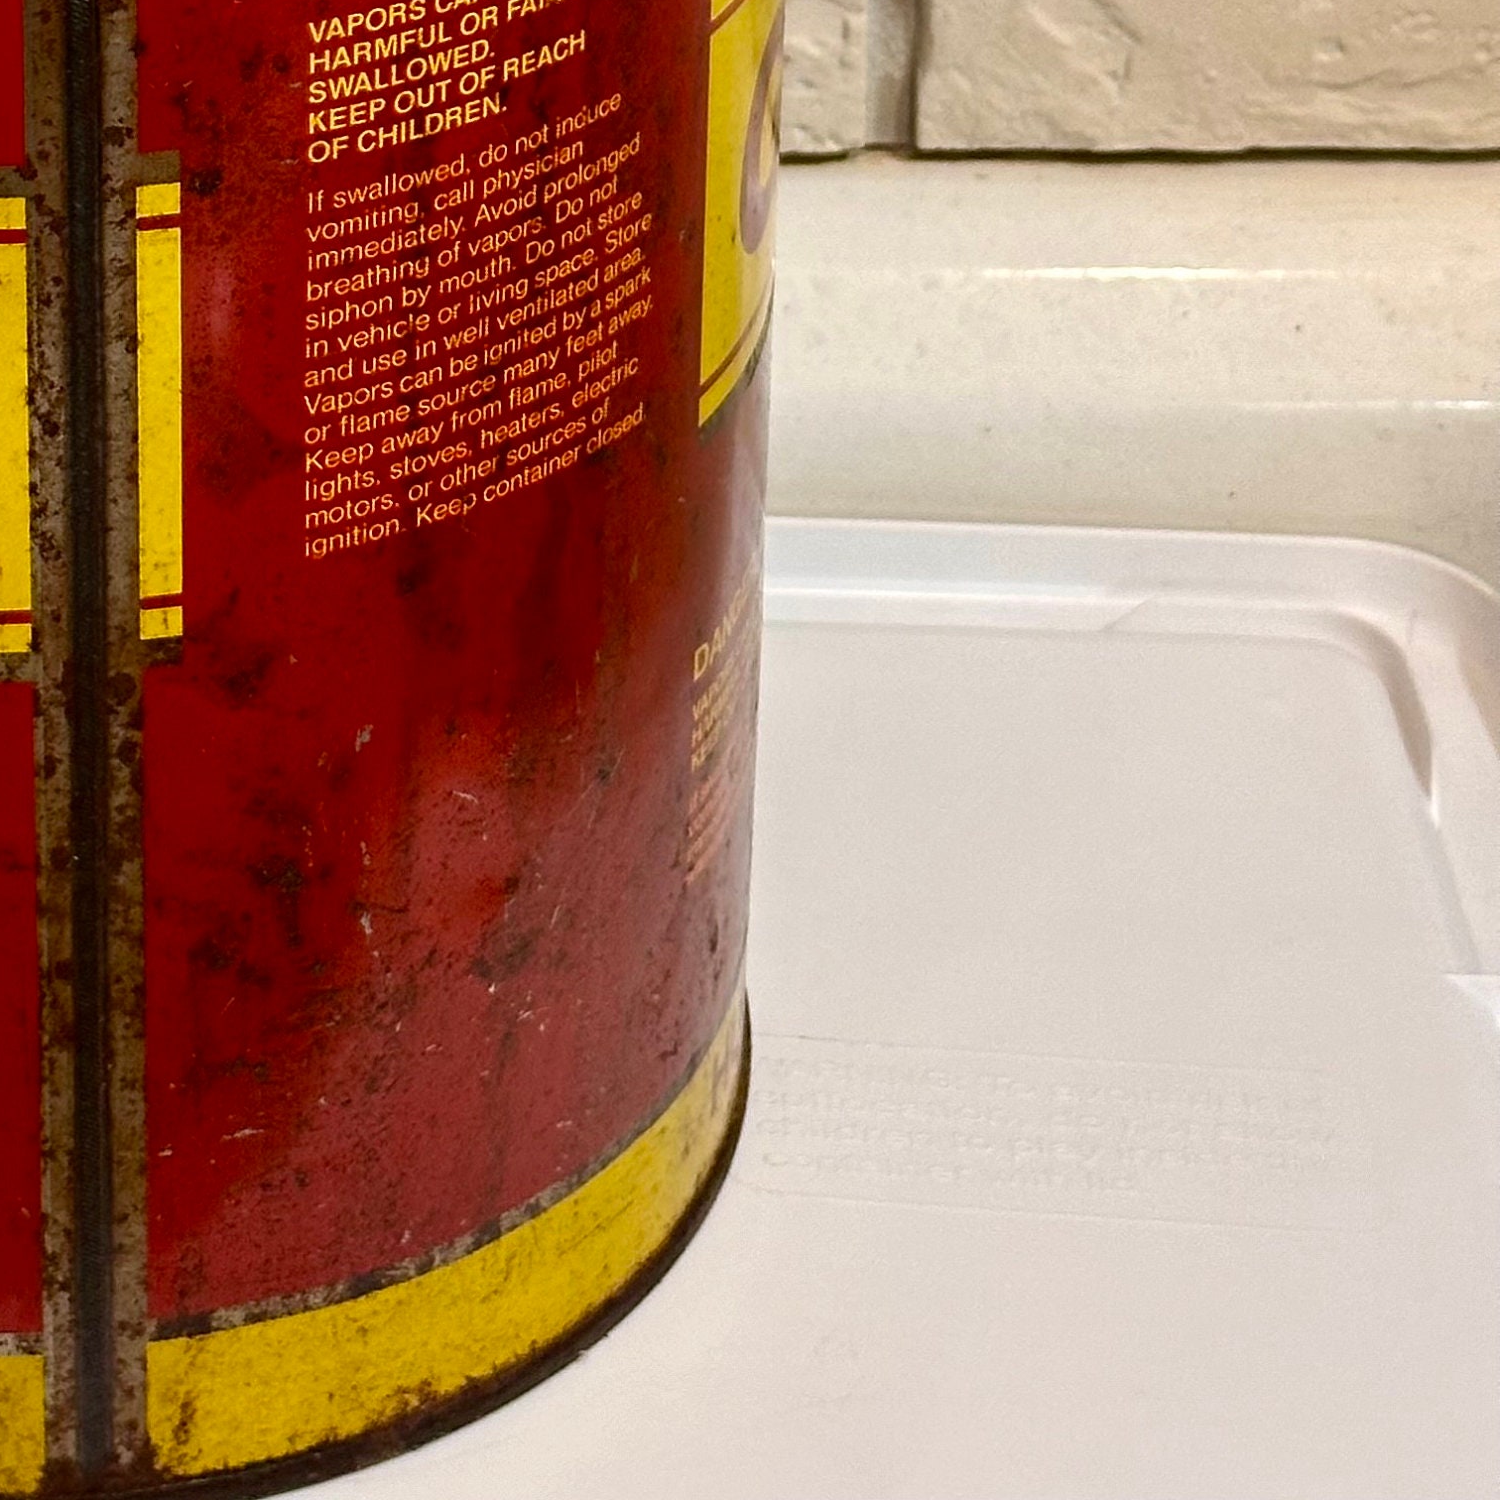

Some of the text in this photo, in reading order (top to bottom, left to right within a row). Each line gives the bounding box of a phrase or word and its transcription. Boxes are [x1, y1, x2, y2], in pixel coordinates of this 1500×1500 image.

[307, 39, 496, 103] SWALLOWED.
[308, 22, 453, 74] HARMFUL
[459, 5, 499, 36] OR
[308, 29, 586, 135] KEEP OUT OF REACH
[304, 140, 584, 242] vomiting, call physician
[307, 94, 508, 164] OF CHILDREN.
[307, 93, 622, 215] If swallowed, do not induce
[305, 191, 643, 331] siphon by mouth. Do not store
[306, 257, 430, 302] breathing
[436, 240, 461, 268] of
[555, 197, 584, 224] Do
[589, 174, 618, 207] not
[307, 133, 641, 271] immediately. Avoid prolonged
[303, 357, 354, 388] and
[362, 348, 408, 375] use
[415, 339, 437, 361] in
[442, 316, 490, 351] well
[496, 269, 599, 330] ventilated
[303, 266, 652, 415] Vapors can be ignited by a spark
[305, 337, 329, 359] in
[336, 313, 431, 352] vehicle
[437, 302, 462, 325] or
[469, 278, 529, 314] living
[604, 212, 653, 254] Store
[303, 423, 332, 445] or
[339, 404, 411, 436] flame
[417, 374, 497, 416] source
[503, 347, 561, 384] many
[565, 321, 604, 357] feet
[305, 340, 619, 473] Keep away from flame, pilot
[305, 357, 639, 502] lights, stoves, heaters, electric
[304, 396, 610, 529] motors, or other sources of
[416, 492, 478, 527] Keep
[483, 445, 582, 502] container
